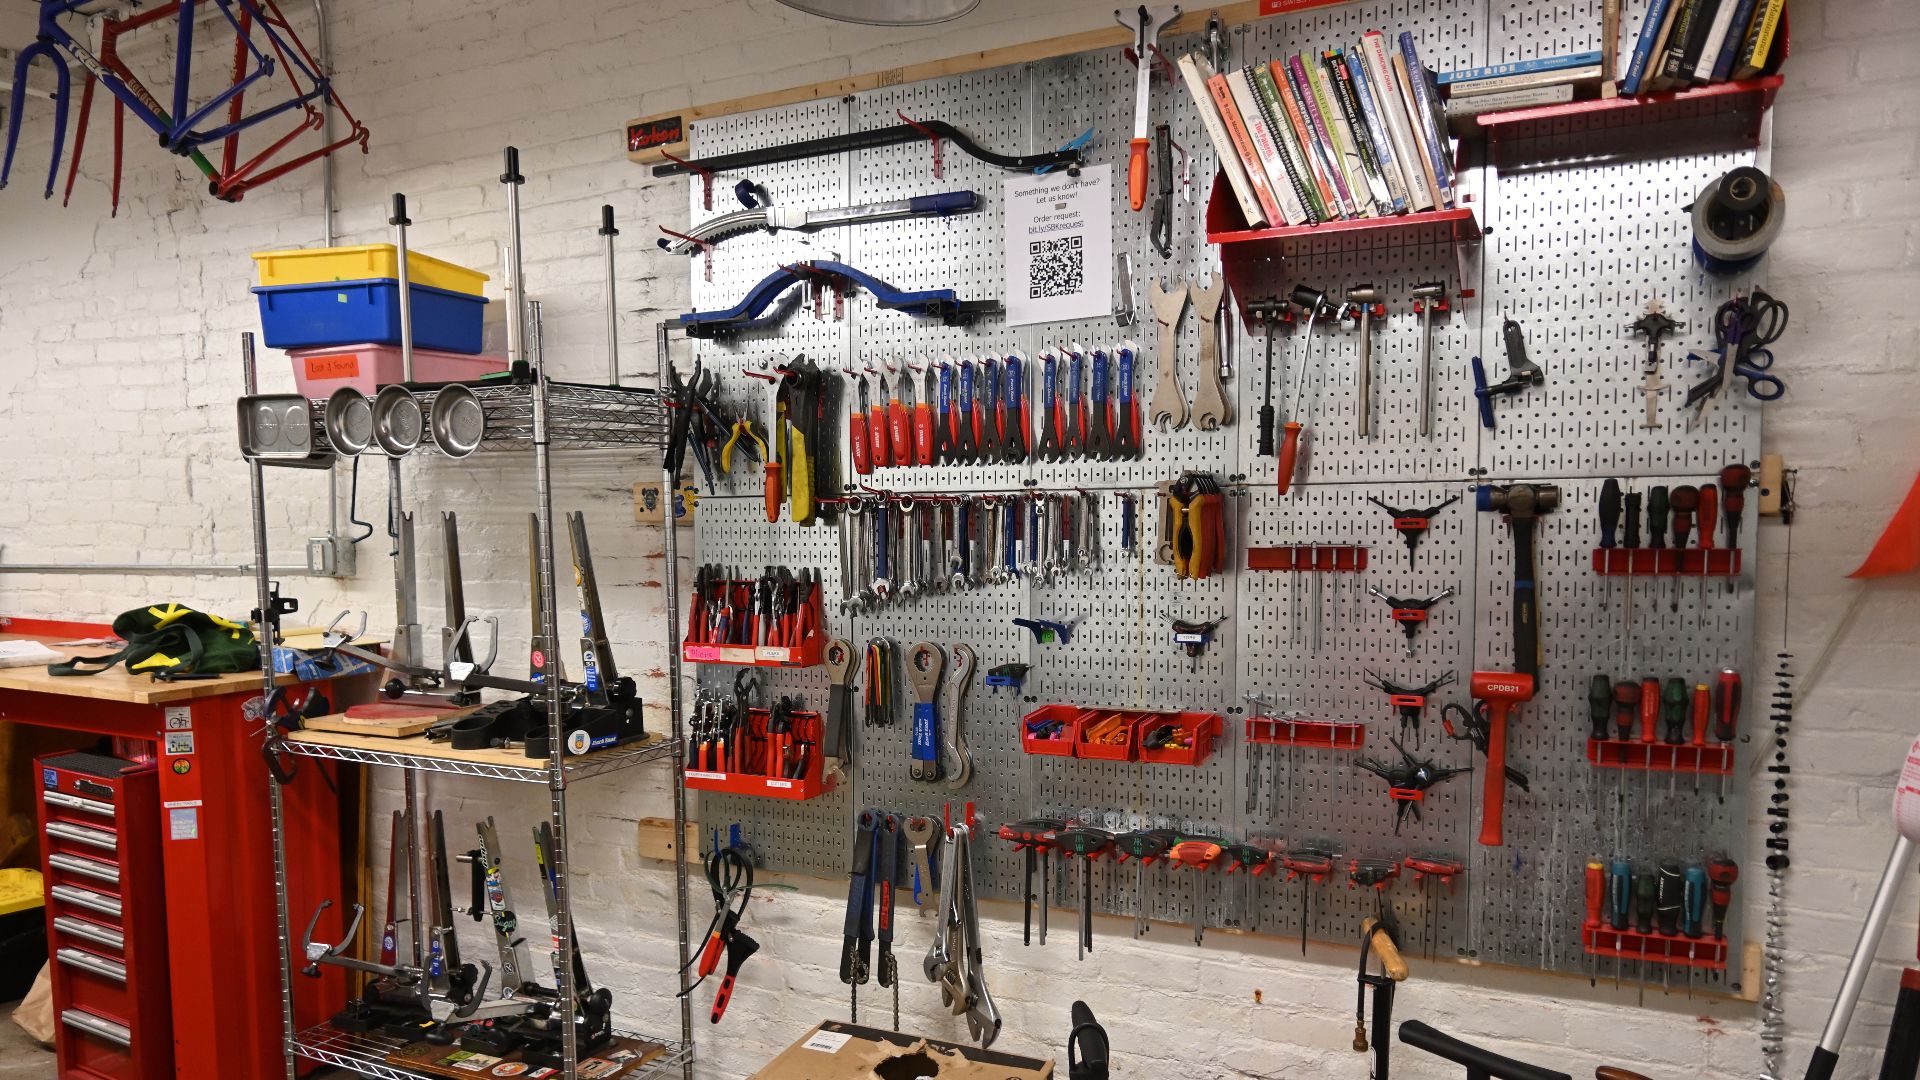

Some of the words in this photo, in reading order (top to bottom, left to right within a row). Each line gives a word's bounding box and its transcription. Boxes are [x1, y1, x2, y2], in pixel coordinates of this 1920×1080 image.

[1755, 2, 1780, 57] Maintenance
[1372, 38, 1380, 49] THE
[66, 39, 104, 82] TREK
[1330, 59, 1343, 81] BICYCLE
[1375, 48, 1388, 74] DANCING
[1448, 68, 1479, 80] JUST
[1483, 63, 1516, 75] RIDE
[1383, 74, 1393, 92] CHAIN
[1301, 82, 1319, 117] BARNETT'S
[1336, 80, 1356, 118] MAINTENANCE
[1296, 99, 1311, 124] Bicycle
[1351, 122, 1364, 142] REPAIR
[1014, 185, 1049, 198] Something
[1062, 182, 1078, 190] don't
[1080, 178, 1100, 188] have?
[1058, 192, 1078, 200] know!
[1034, 215, 1052, 224] Order
[1054, 211, 1080, 222] request:
[1487, 684, 1519, 693] CPDB21
